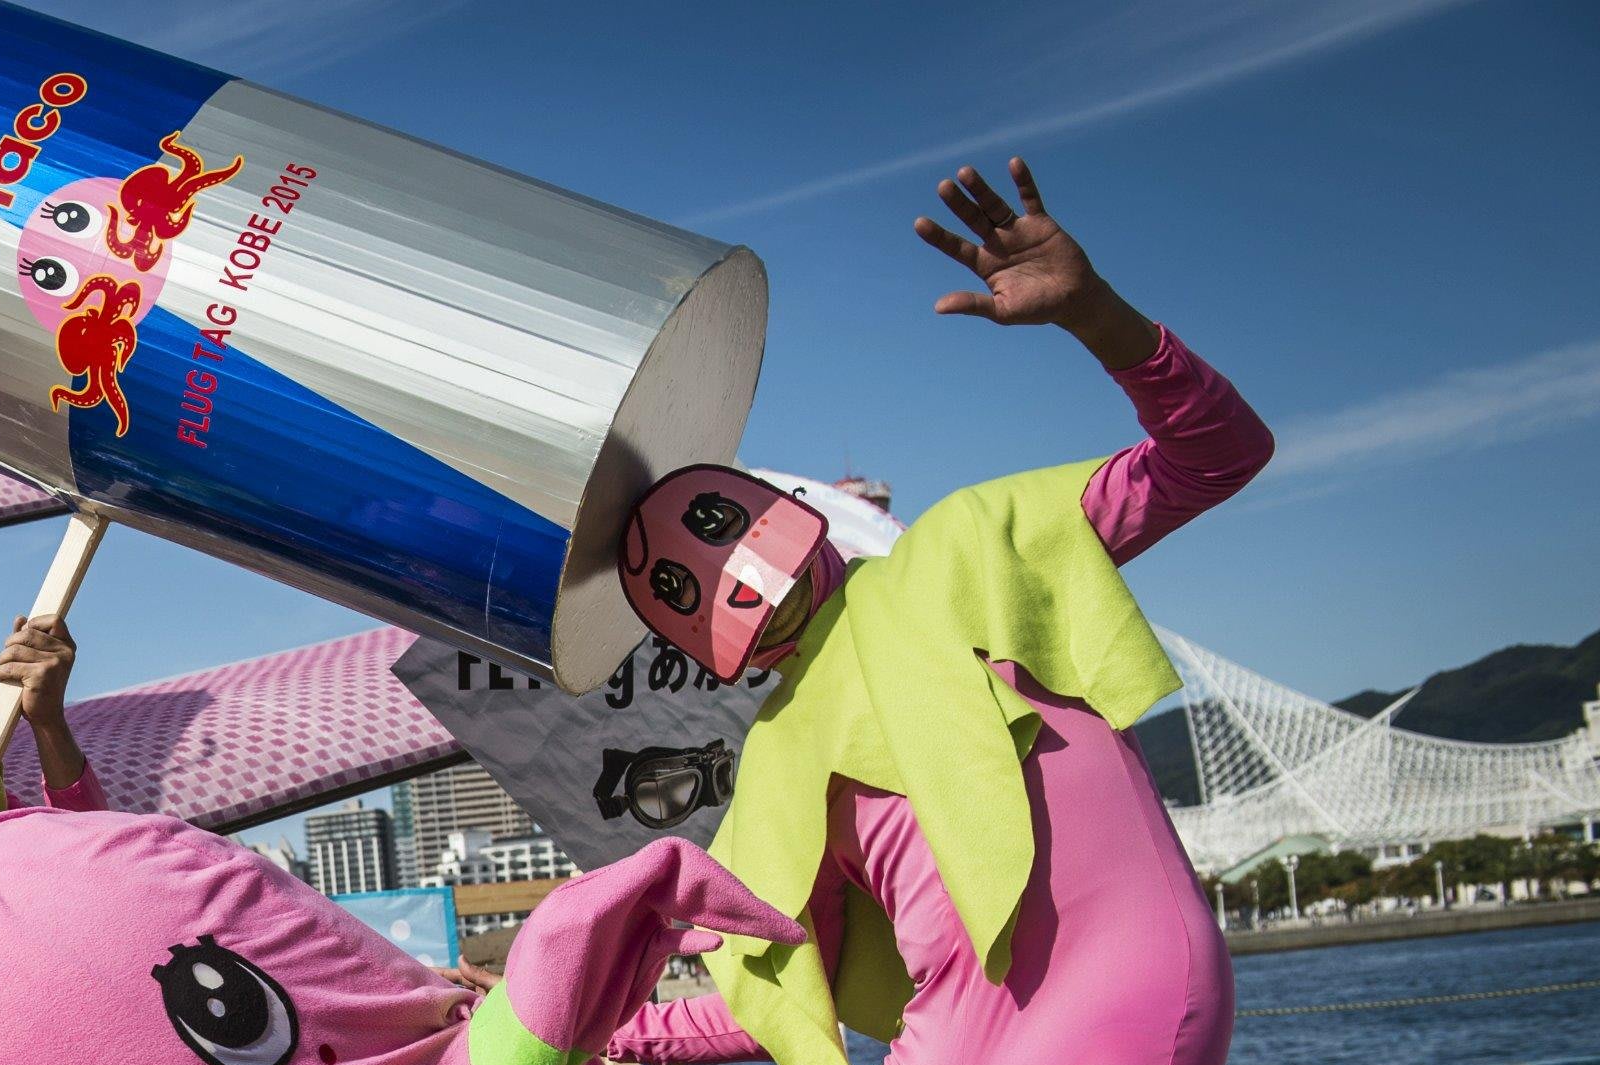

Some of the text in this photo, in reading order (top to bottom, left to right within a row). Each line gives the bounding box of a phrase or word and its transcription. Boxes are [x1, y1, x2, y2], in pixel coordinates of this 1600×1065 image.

[177, 162, 319, 448] FLUG TAG KOBE 2015
